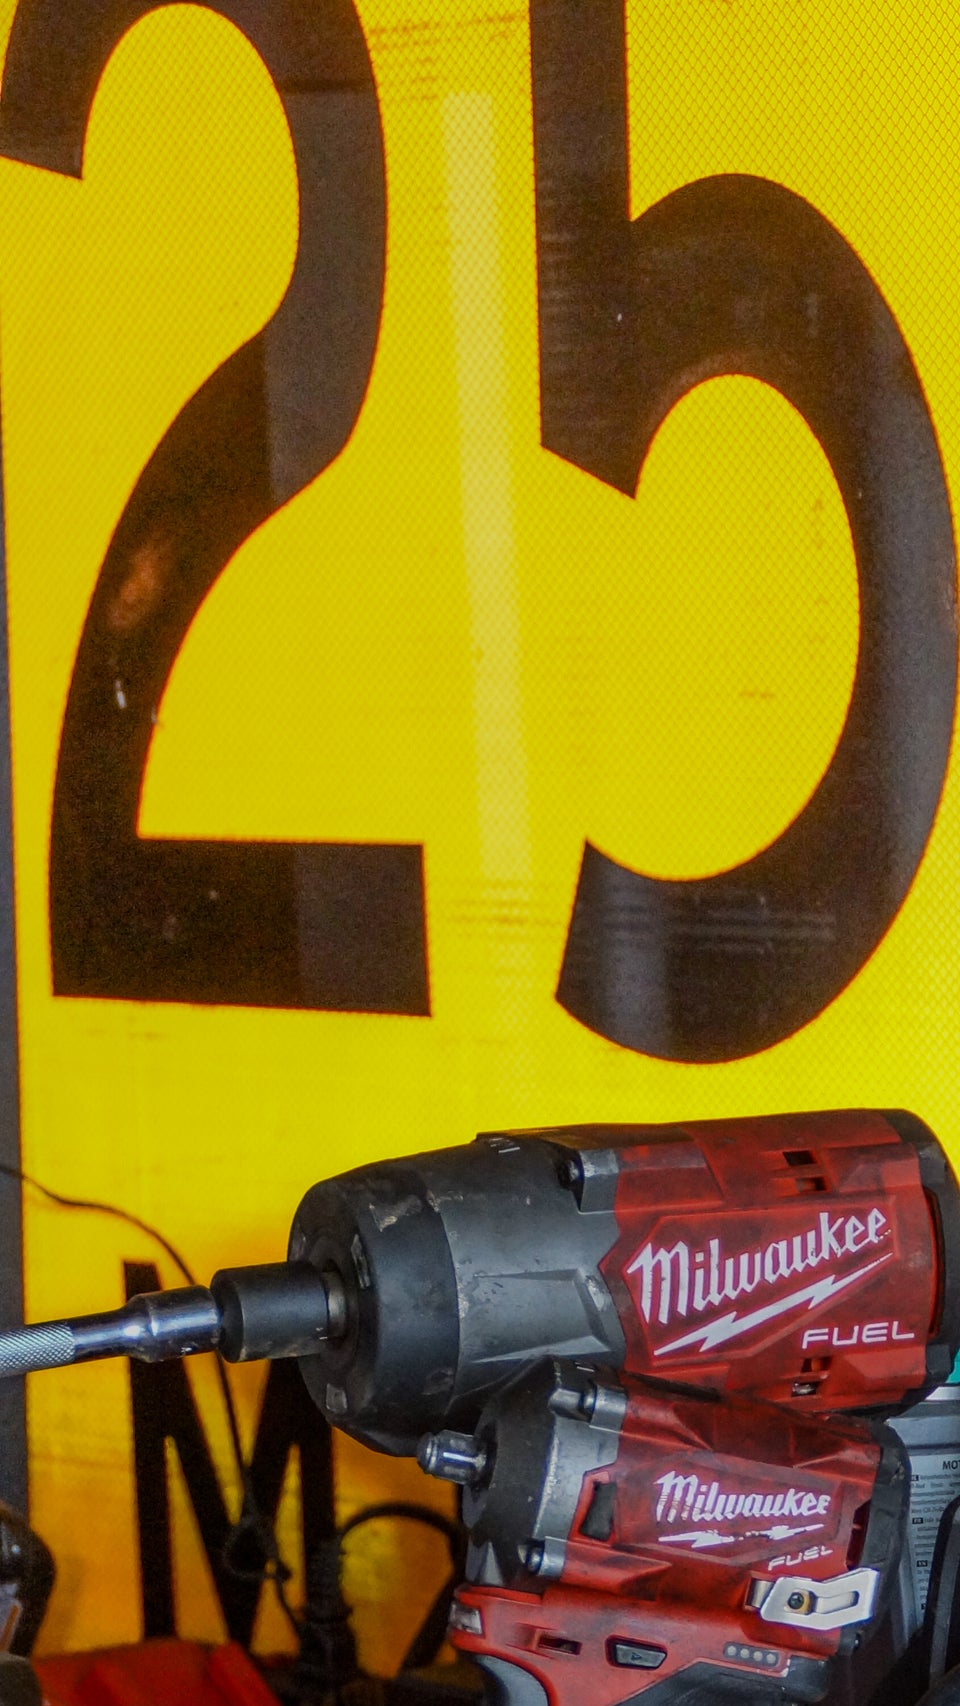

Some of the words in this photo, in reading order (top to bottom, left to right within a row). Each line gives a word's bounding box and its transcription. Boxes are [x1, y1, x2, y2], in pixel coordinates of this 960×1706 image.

[0, 0, 960, 1064] 25
[627, 1208, 891, 1324] Milwaukee
[802, 1321, 915, 1349] FUEL
[653, 1470, 831, 1523] Milwaukee
[767, 1545, 833, 1571] FUEL
